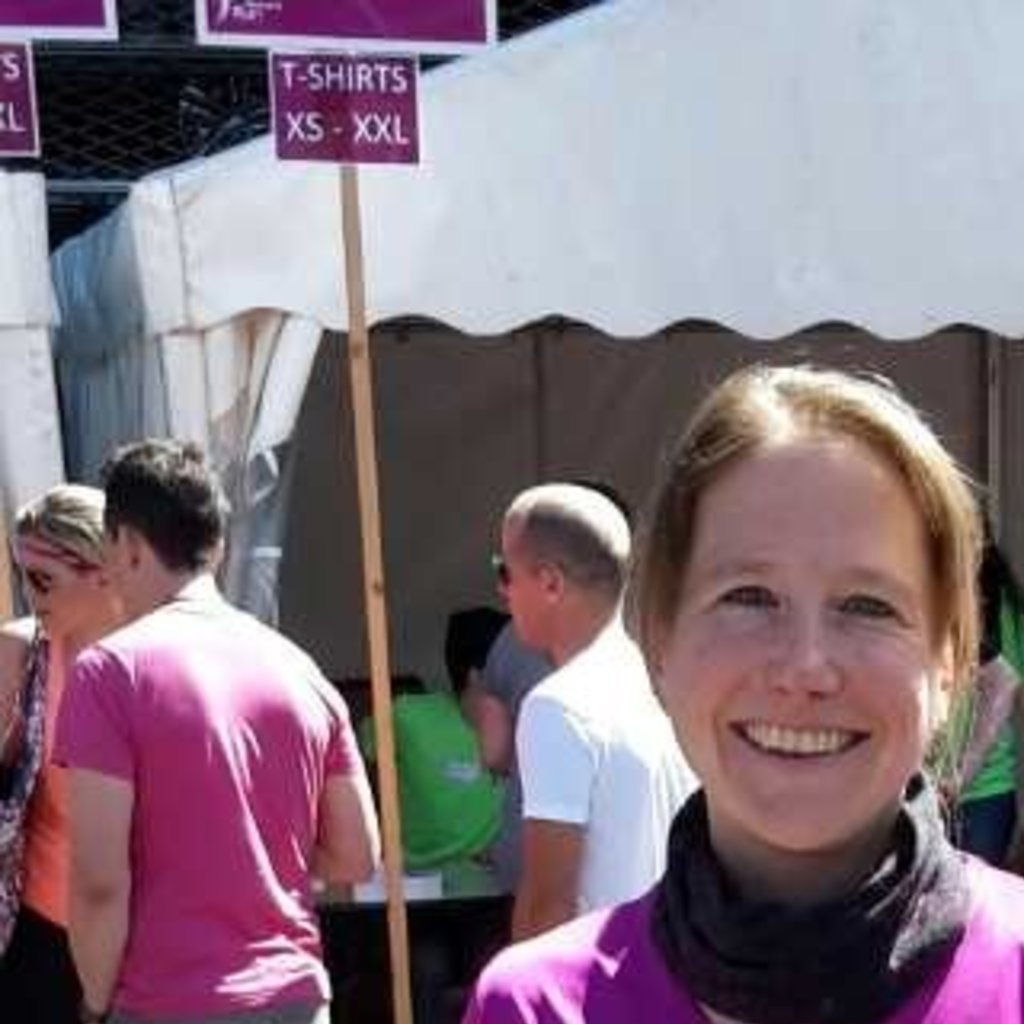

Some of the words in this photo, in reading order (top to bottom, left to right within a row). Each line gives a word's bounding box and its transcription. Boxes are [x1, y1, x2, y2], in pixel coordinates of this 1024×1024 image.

[280, 62, 408, 94] T-SHIRTS
[286, 111, 325, 143] XS
[353, 113, 411, 145] XXL
